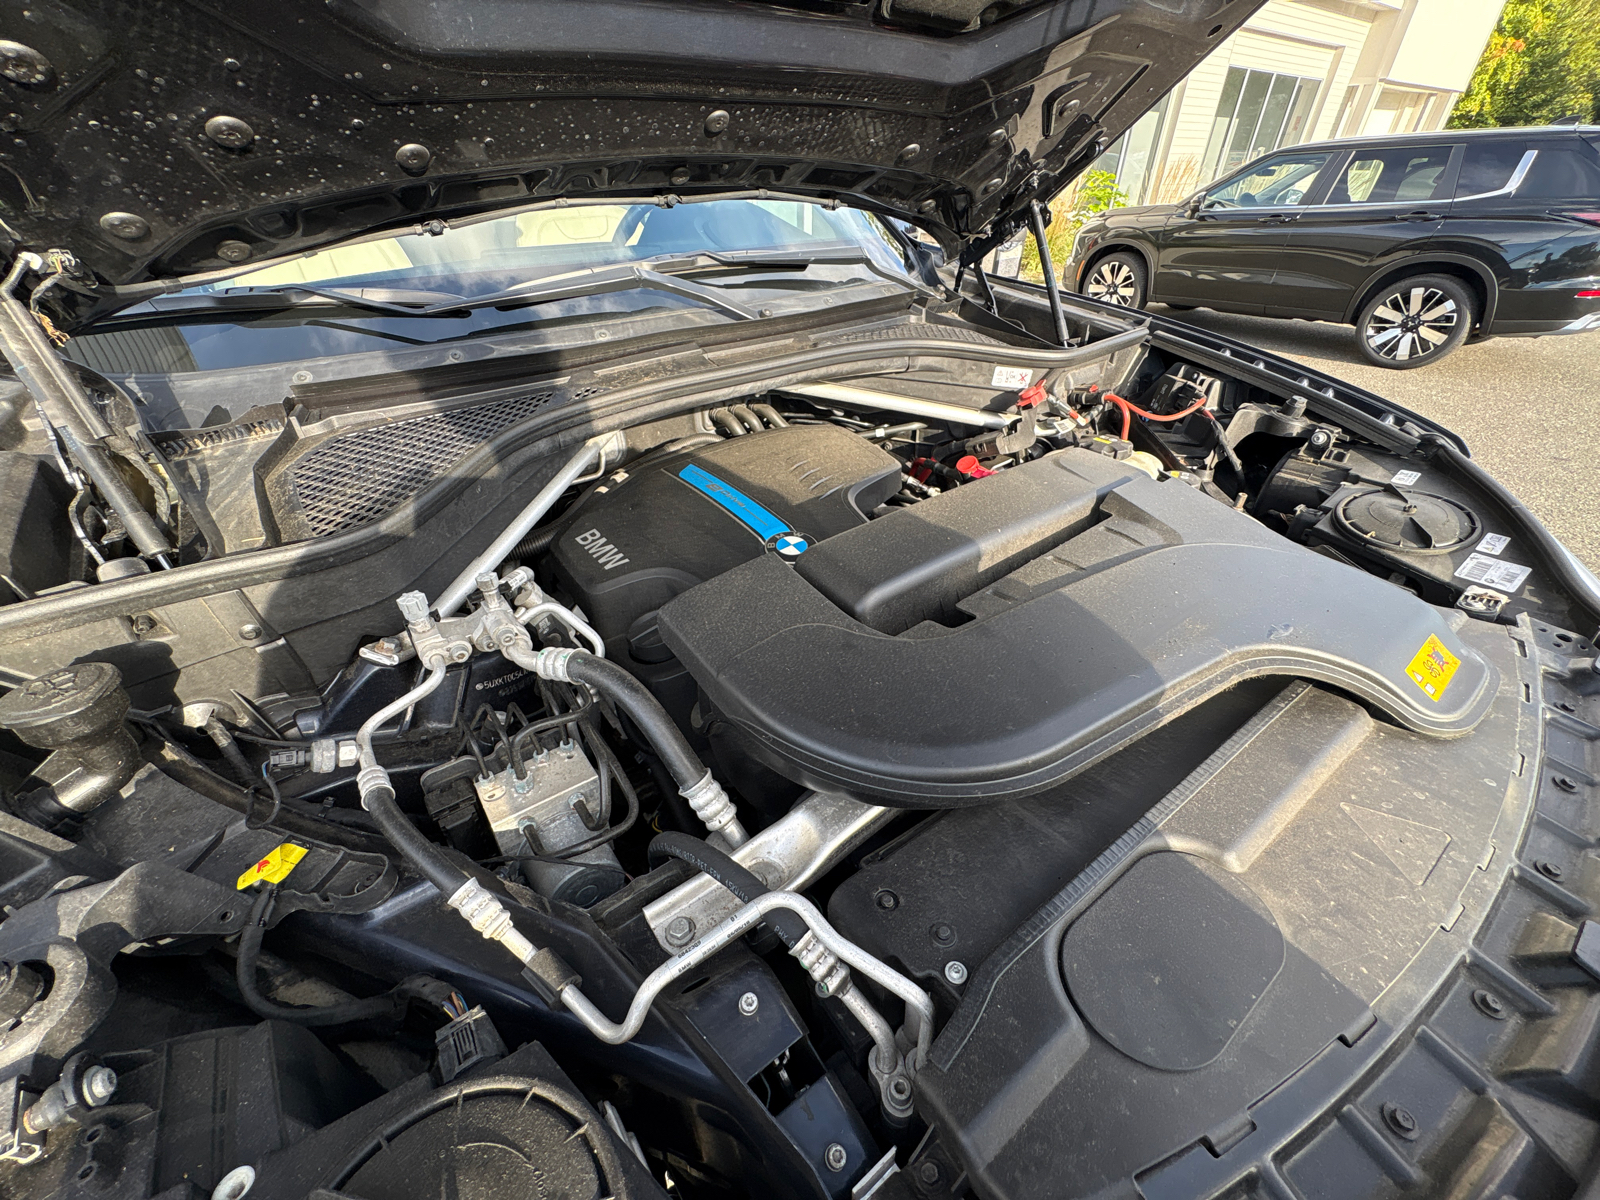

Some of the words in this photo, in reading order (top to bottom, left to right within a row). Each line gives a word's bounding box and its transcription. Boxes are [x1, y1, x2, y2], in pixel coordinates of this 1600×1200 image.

[574, 528, 630, 570] BMW
[767, 531, 804, 549] BMW
[677, 960, 692, 973] BMW
